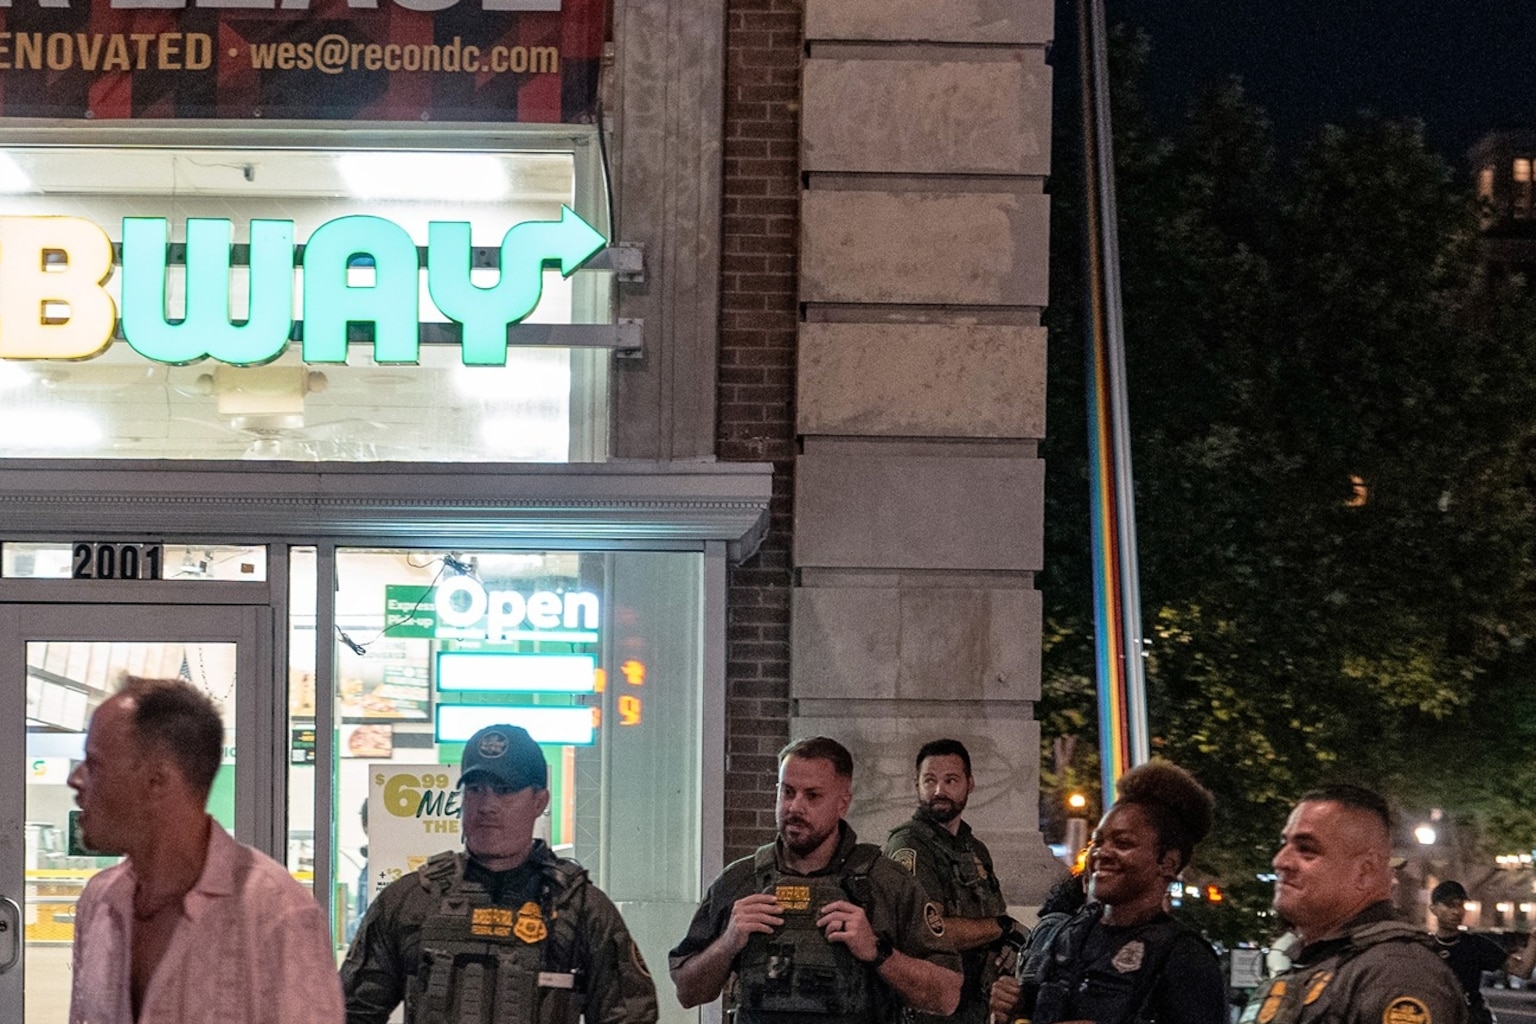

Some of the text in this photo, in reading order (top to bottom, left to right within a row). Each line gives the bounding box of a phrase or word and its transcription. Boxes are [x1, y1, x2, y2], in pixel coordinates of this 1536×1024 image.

[250, 33, 559, 75] wes@recondc.com
[73, 543, 160, 579] 2001
[434, 574, 600, 643] Open
[422, 820, 459, 834] THE
